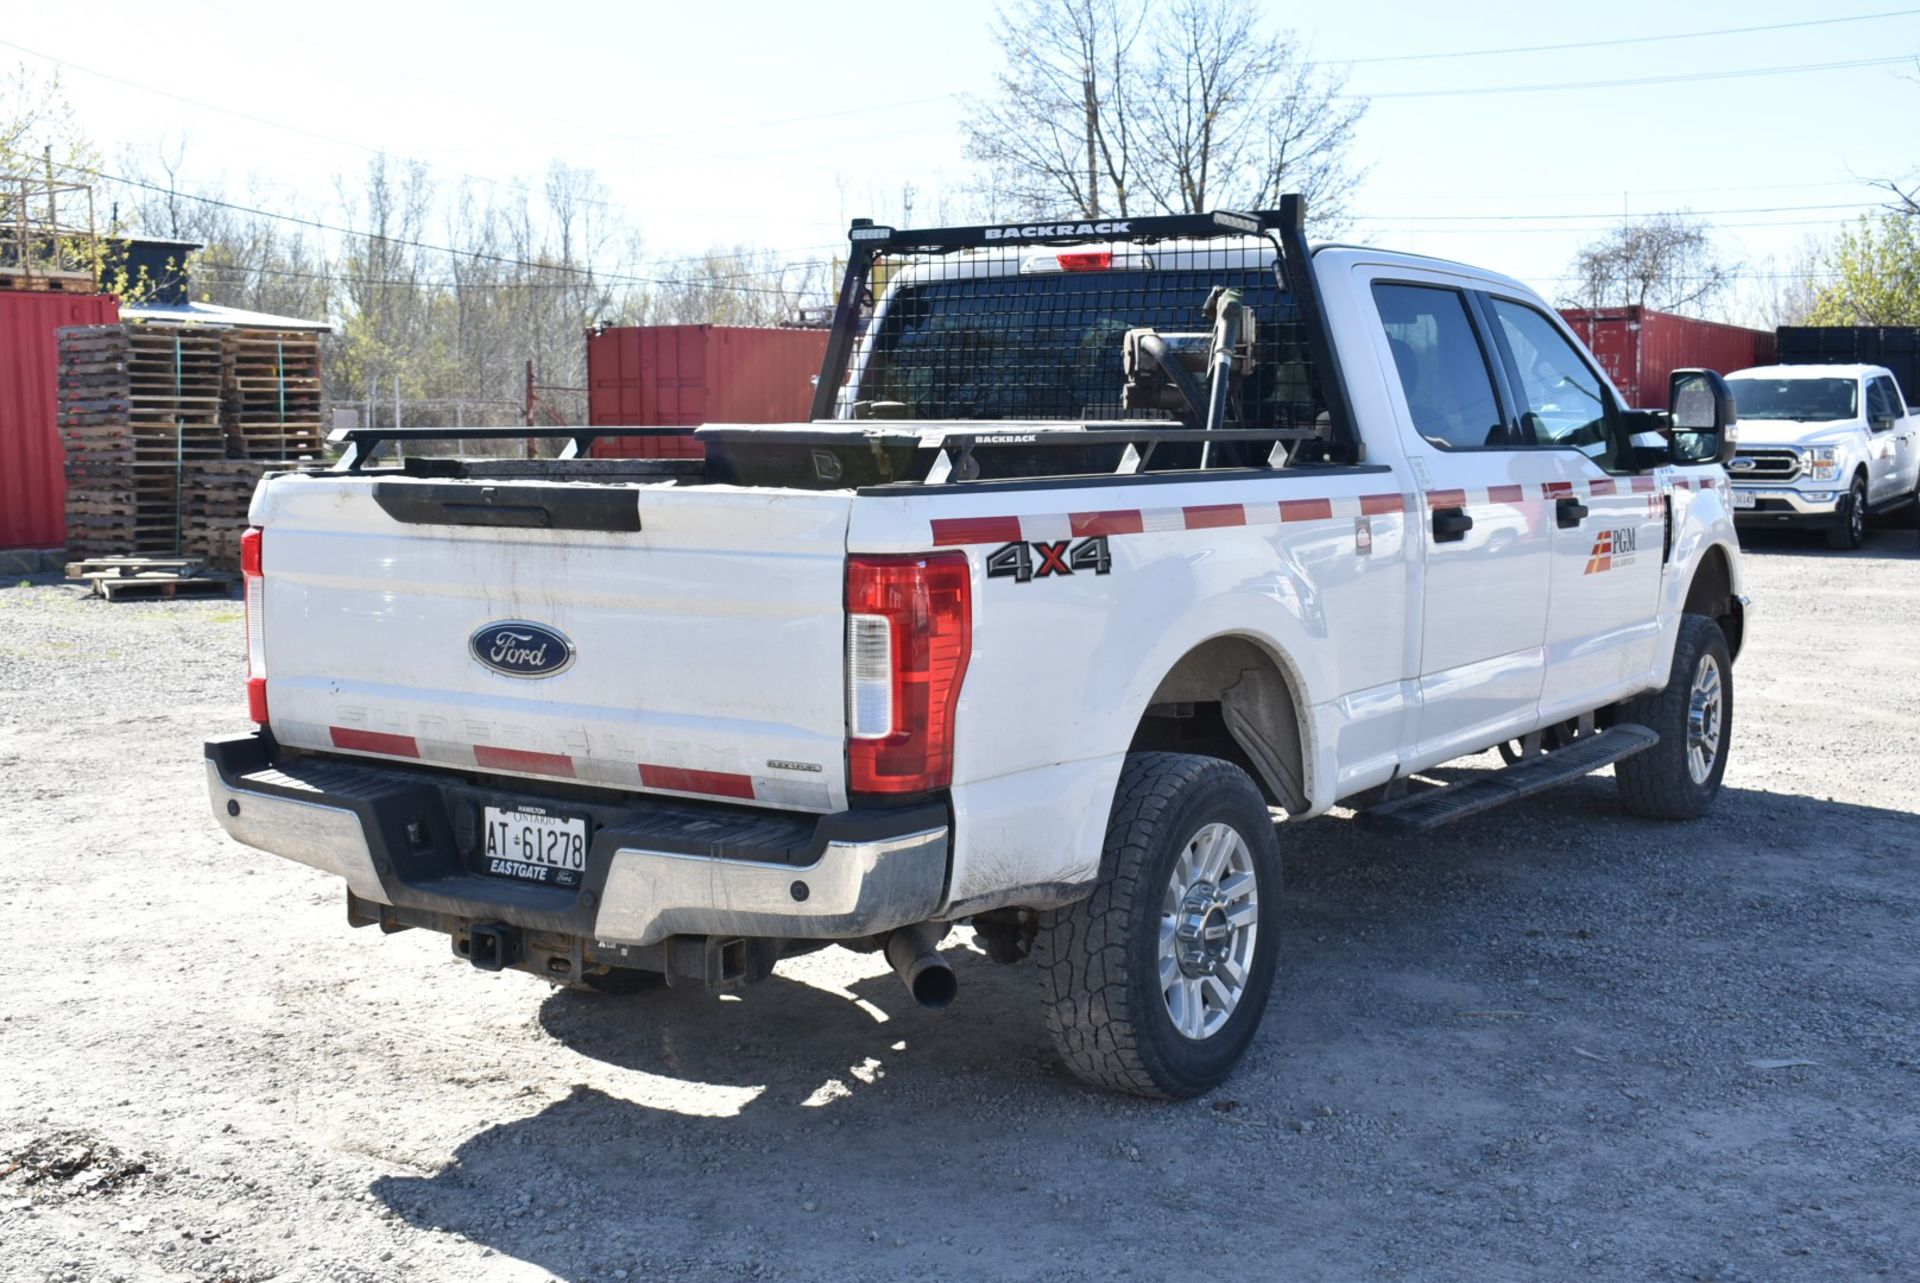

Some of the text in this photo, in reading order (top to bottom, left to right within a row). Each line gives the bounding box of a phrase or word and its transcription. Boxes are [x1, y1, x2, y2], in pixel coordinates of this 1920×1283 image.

[985, 222, 1131, 239] BACKRACK
[975, 435, 1036, 443] BACKRACK
[1613, 528, 1636, 554] PGM
[490, 631, 547, 666] Ford
[518, 806, 546, 815] HAMILTON
[487, 820, 583, 869] AT 61278
[490, 859, 548, 880] EASTGATE
